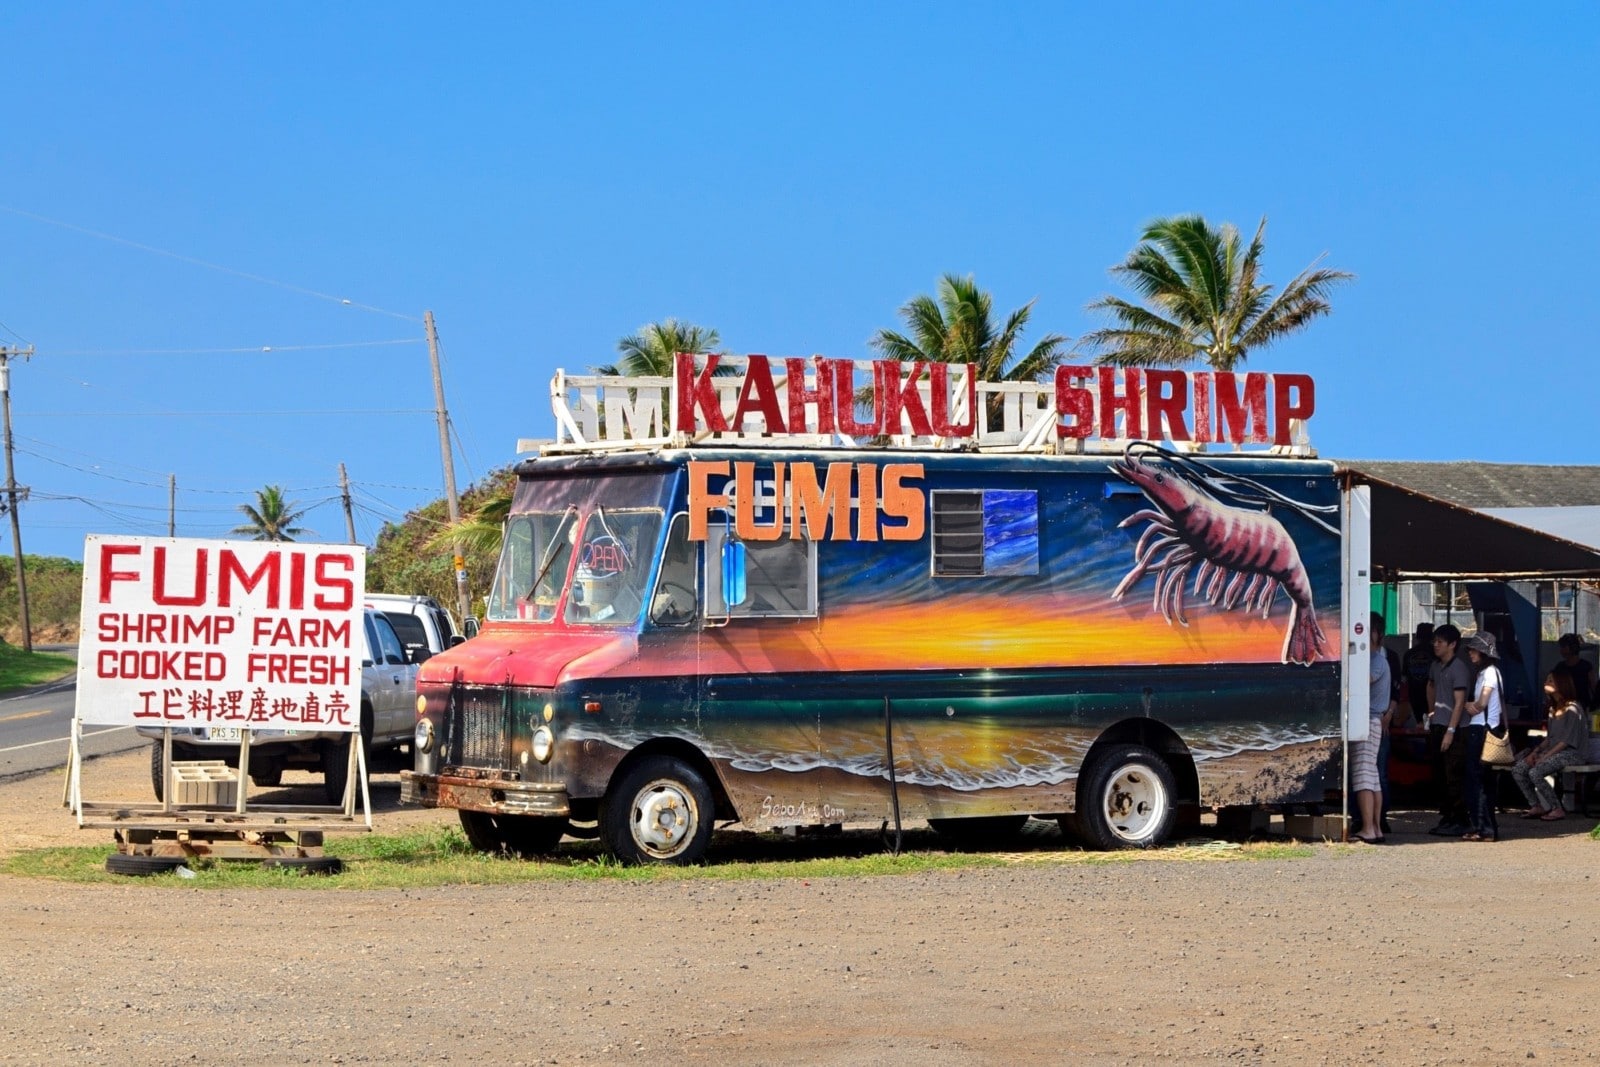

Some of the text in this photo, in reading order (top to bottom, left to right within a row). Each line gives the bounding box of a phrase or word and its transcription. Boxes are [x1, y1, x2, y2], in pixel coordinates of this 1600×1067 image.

[675, 353, 976, 437] KAHUKU
[1055, 365, 1314, 445] SHRIMP
[687, 461, 925, 541] FUMIS
[582, 543, 624, 571] OPEN
[99, 544, 354, 611] FUMIS
[98, 613, 350, 648] SHRIMP FARM
[97, 650, 350, 685] COOKED FRESH
[133, 688, 350, 725] エビ料理産地直売
